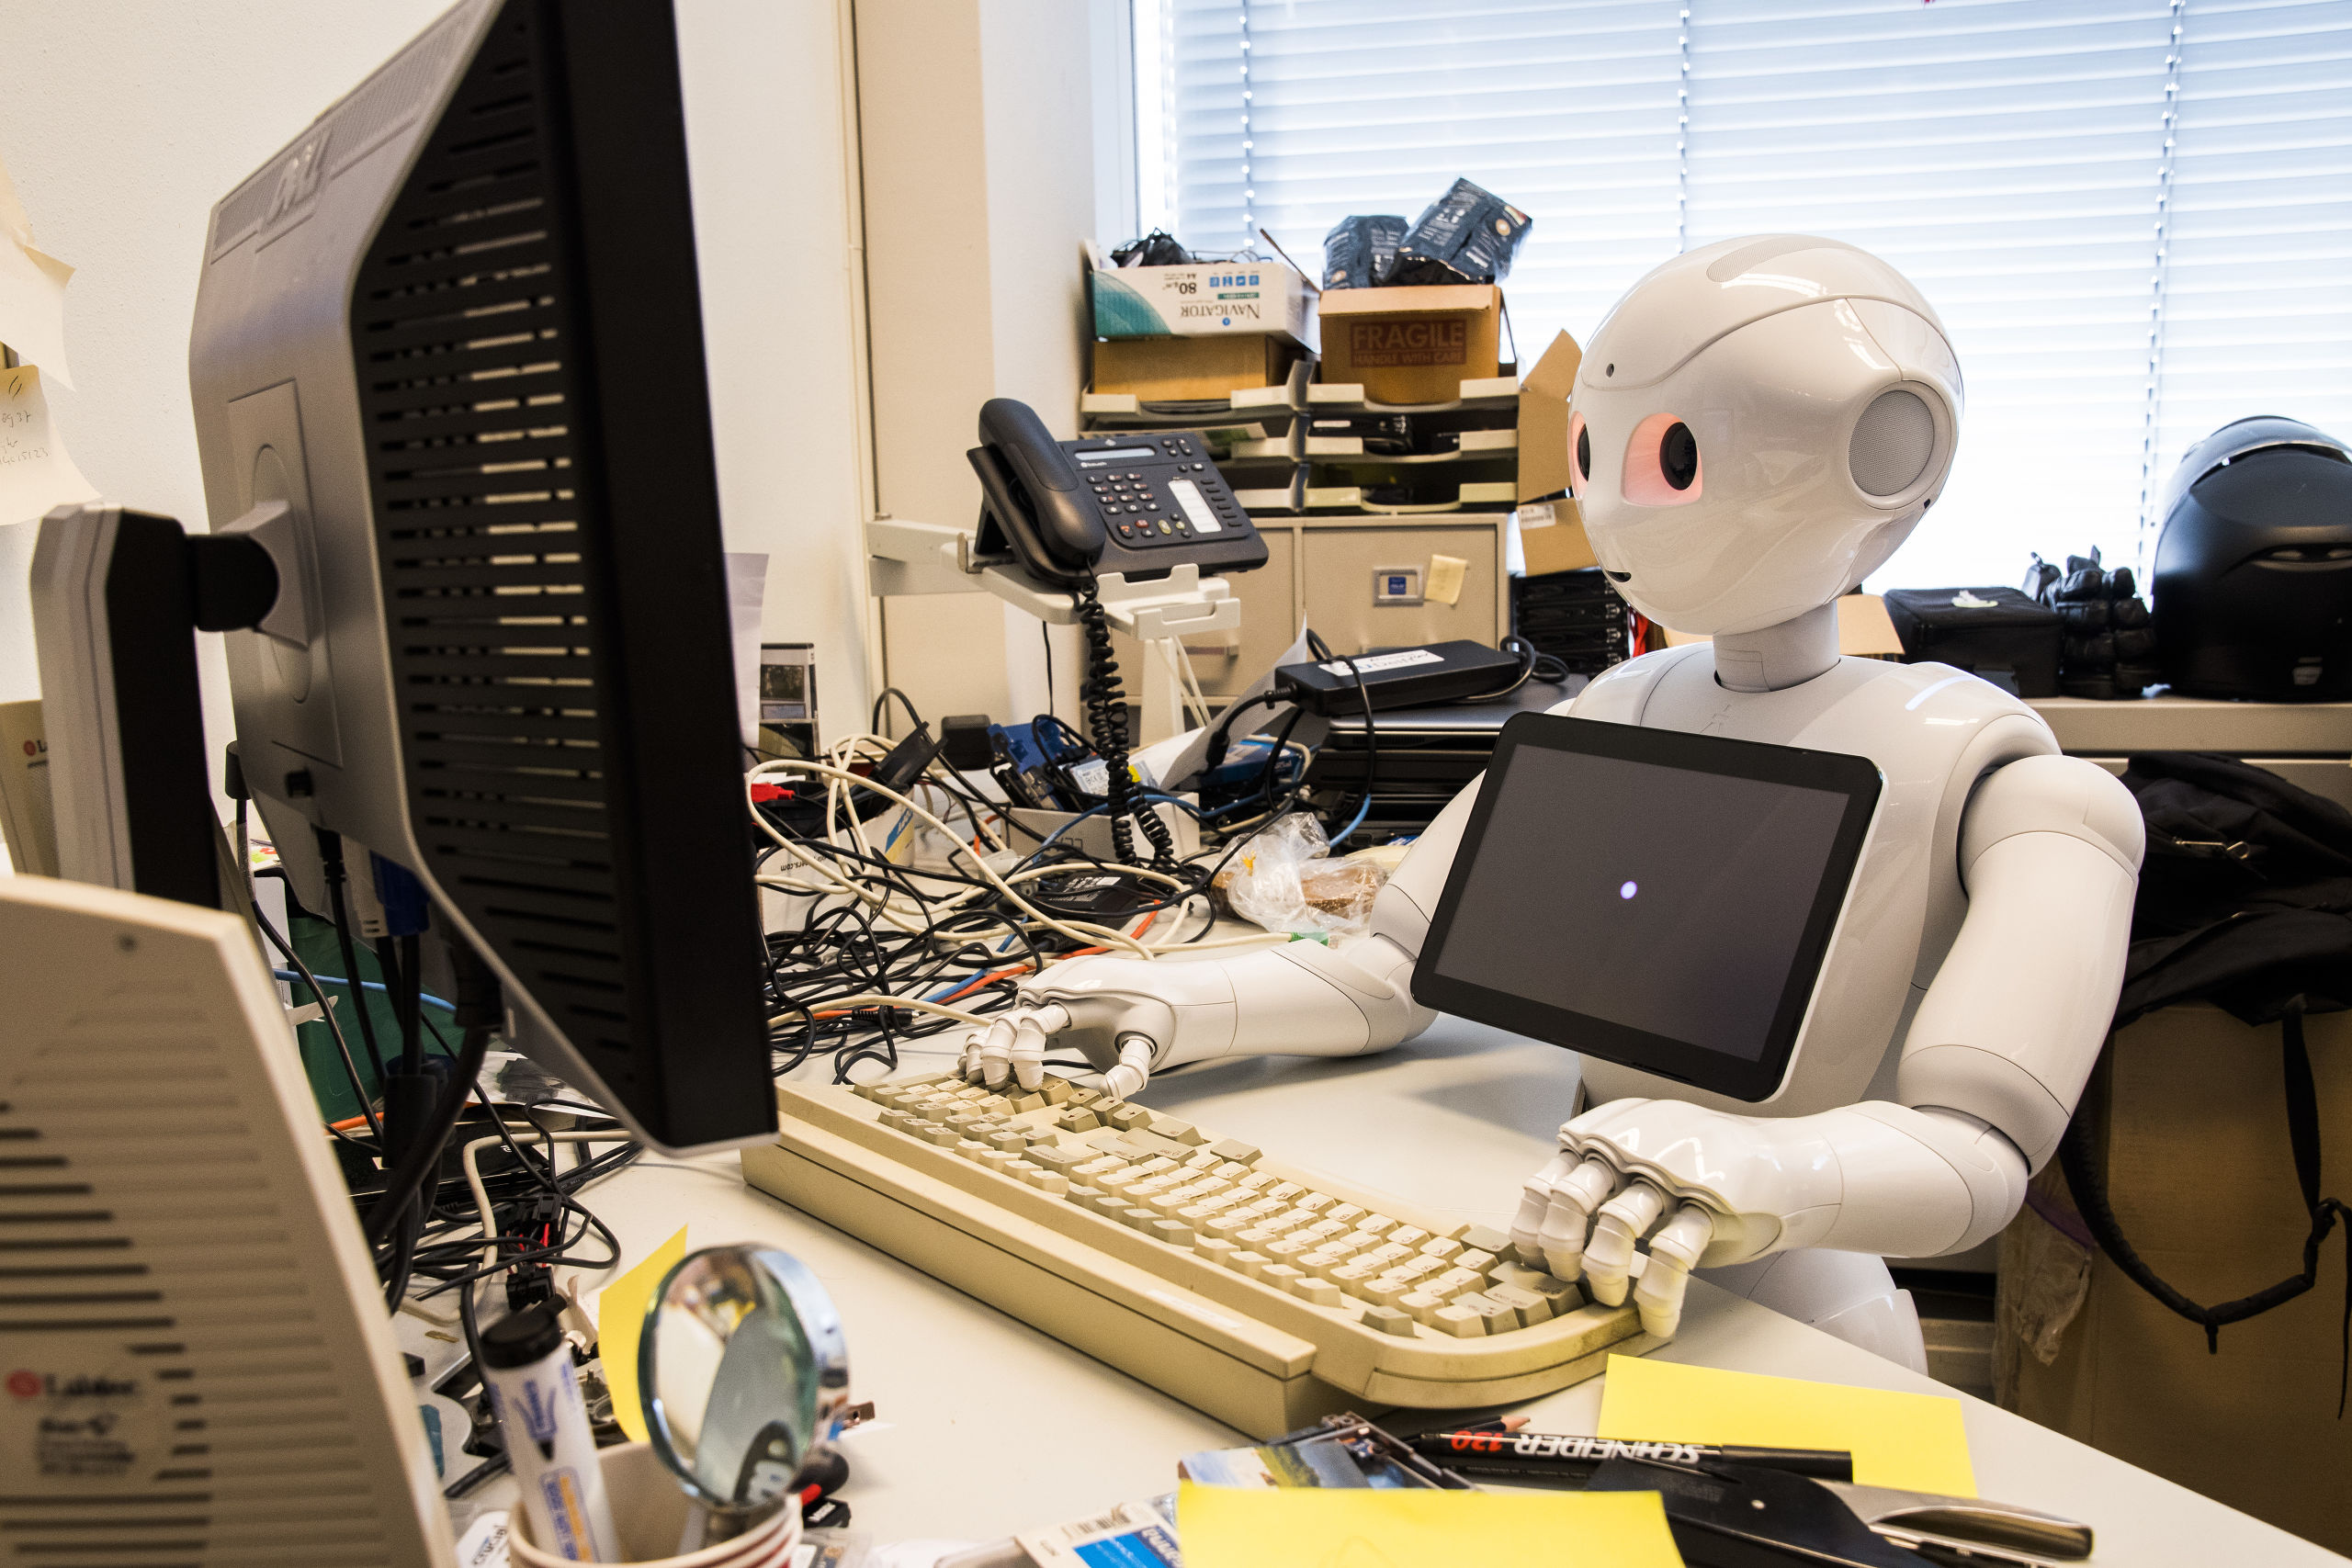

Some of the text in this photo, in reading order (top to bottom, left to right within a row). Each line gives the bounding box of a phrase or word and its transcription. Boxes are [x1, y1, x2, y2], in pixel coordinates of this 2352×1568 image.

[1179, 282, 1197, 295] 80
[1353, 322, 1464, 349] FRAGILE
[1353, 351, 1464, 365] HANDLE WITH CARE
[1514, 1434, 1704, 1465] SCHNEIDER
